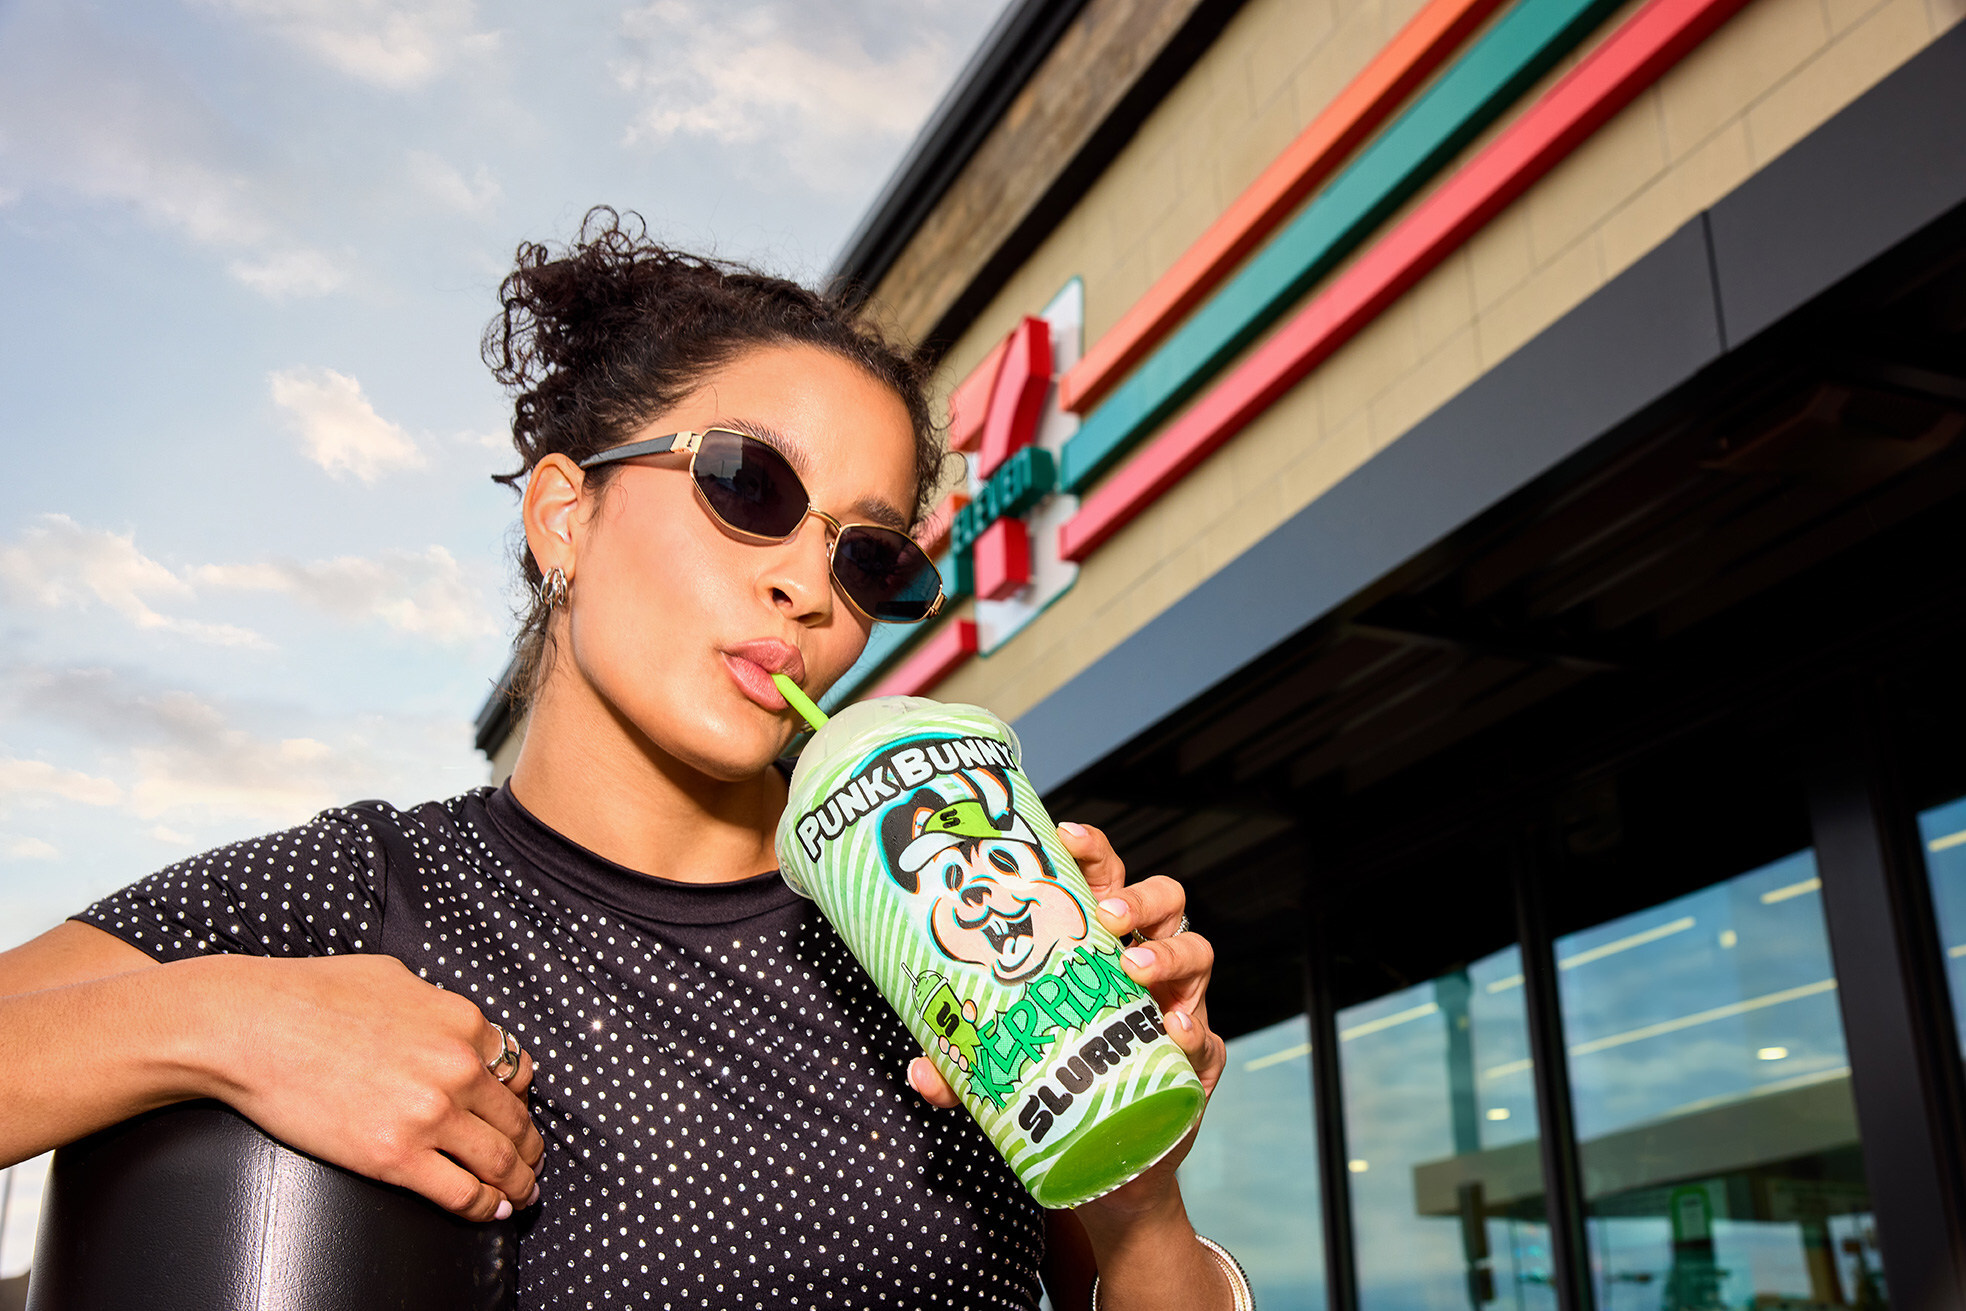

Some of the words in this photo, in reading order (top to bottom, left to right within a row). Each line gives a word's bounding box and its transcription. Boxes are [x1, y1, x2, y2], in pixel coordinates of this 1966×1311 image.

[796, 763, 899, 862] PUNK
[889, 736, 1018, 790] BUNNY
[970, 945, 1150, 1109] KERPLUN
[1018, 1004, 1168, 1144] SLURPEE
